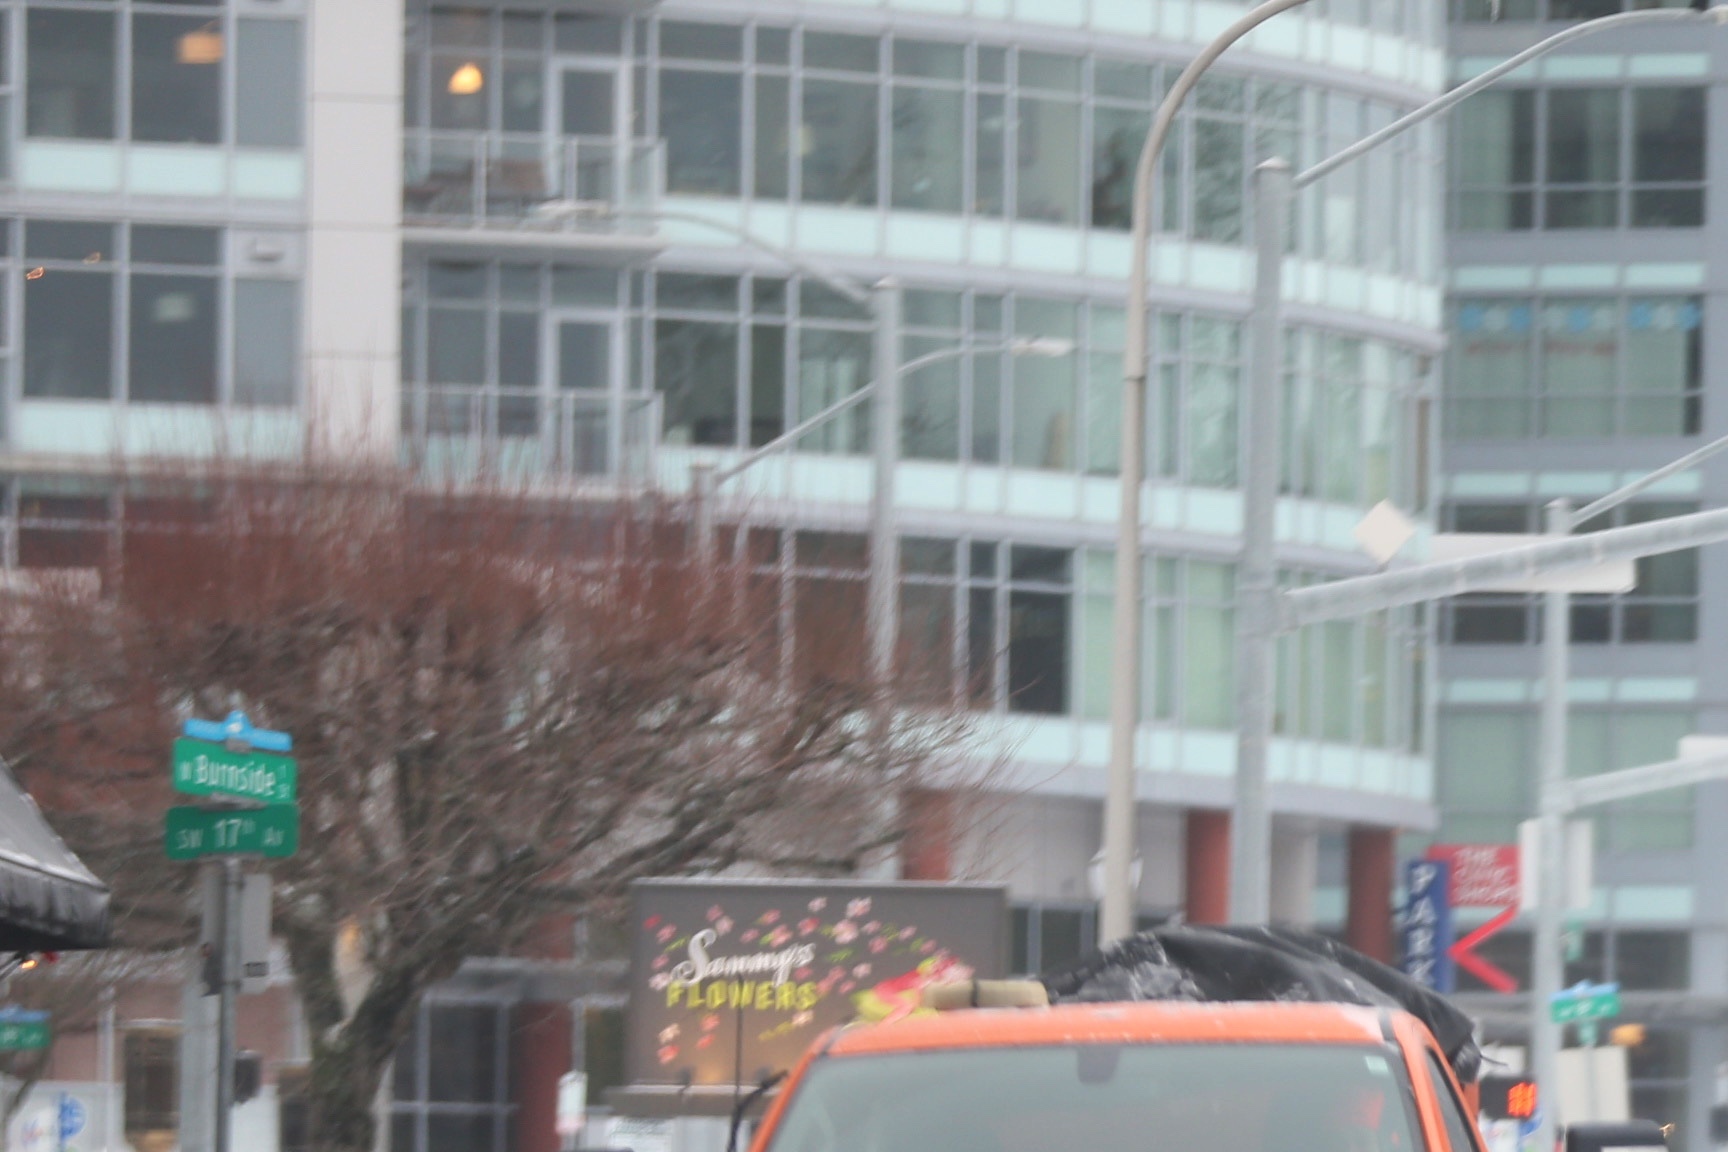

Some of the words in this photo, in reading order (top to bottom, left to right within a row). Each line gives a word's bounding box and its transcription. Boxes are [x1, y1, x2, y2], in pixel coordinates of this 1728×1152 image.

[195, 755, 276, 796] Burnside
[214, 818, 256, 848] 17th
[666, 979, 817, 1011] FLOWERS
